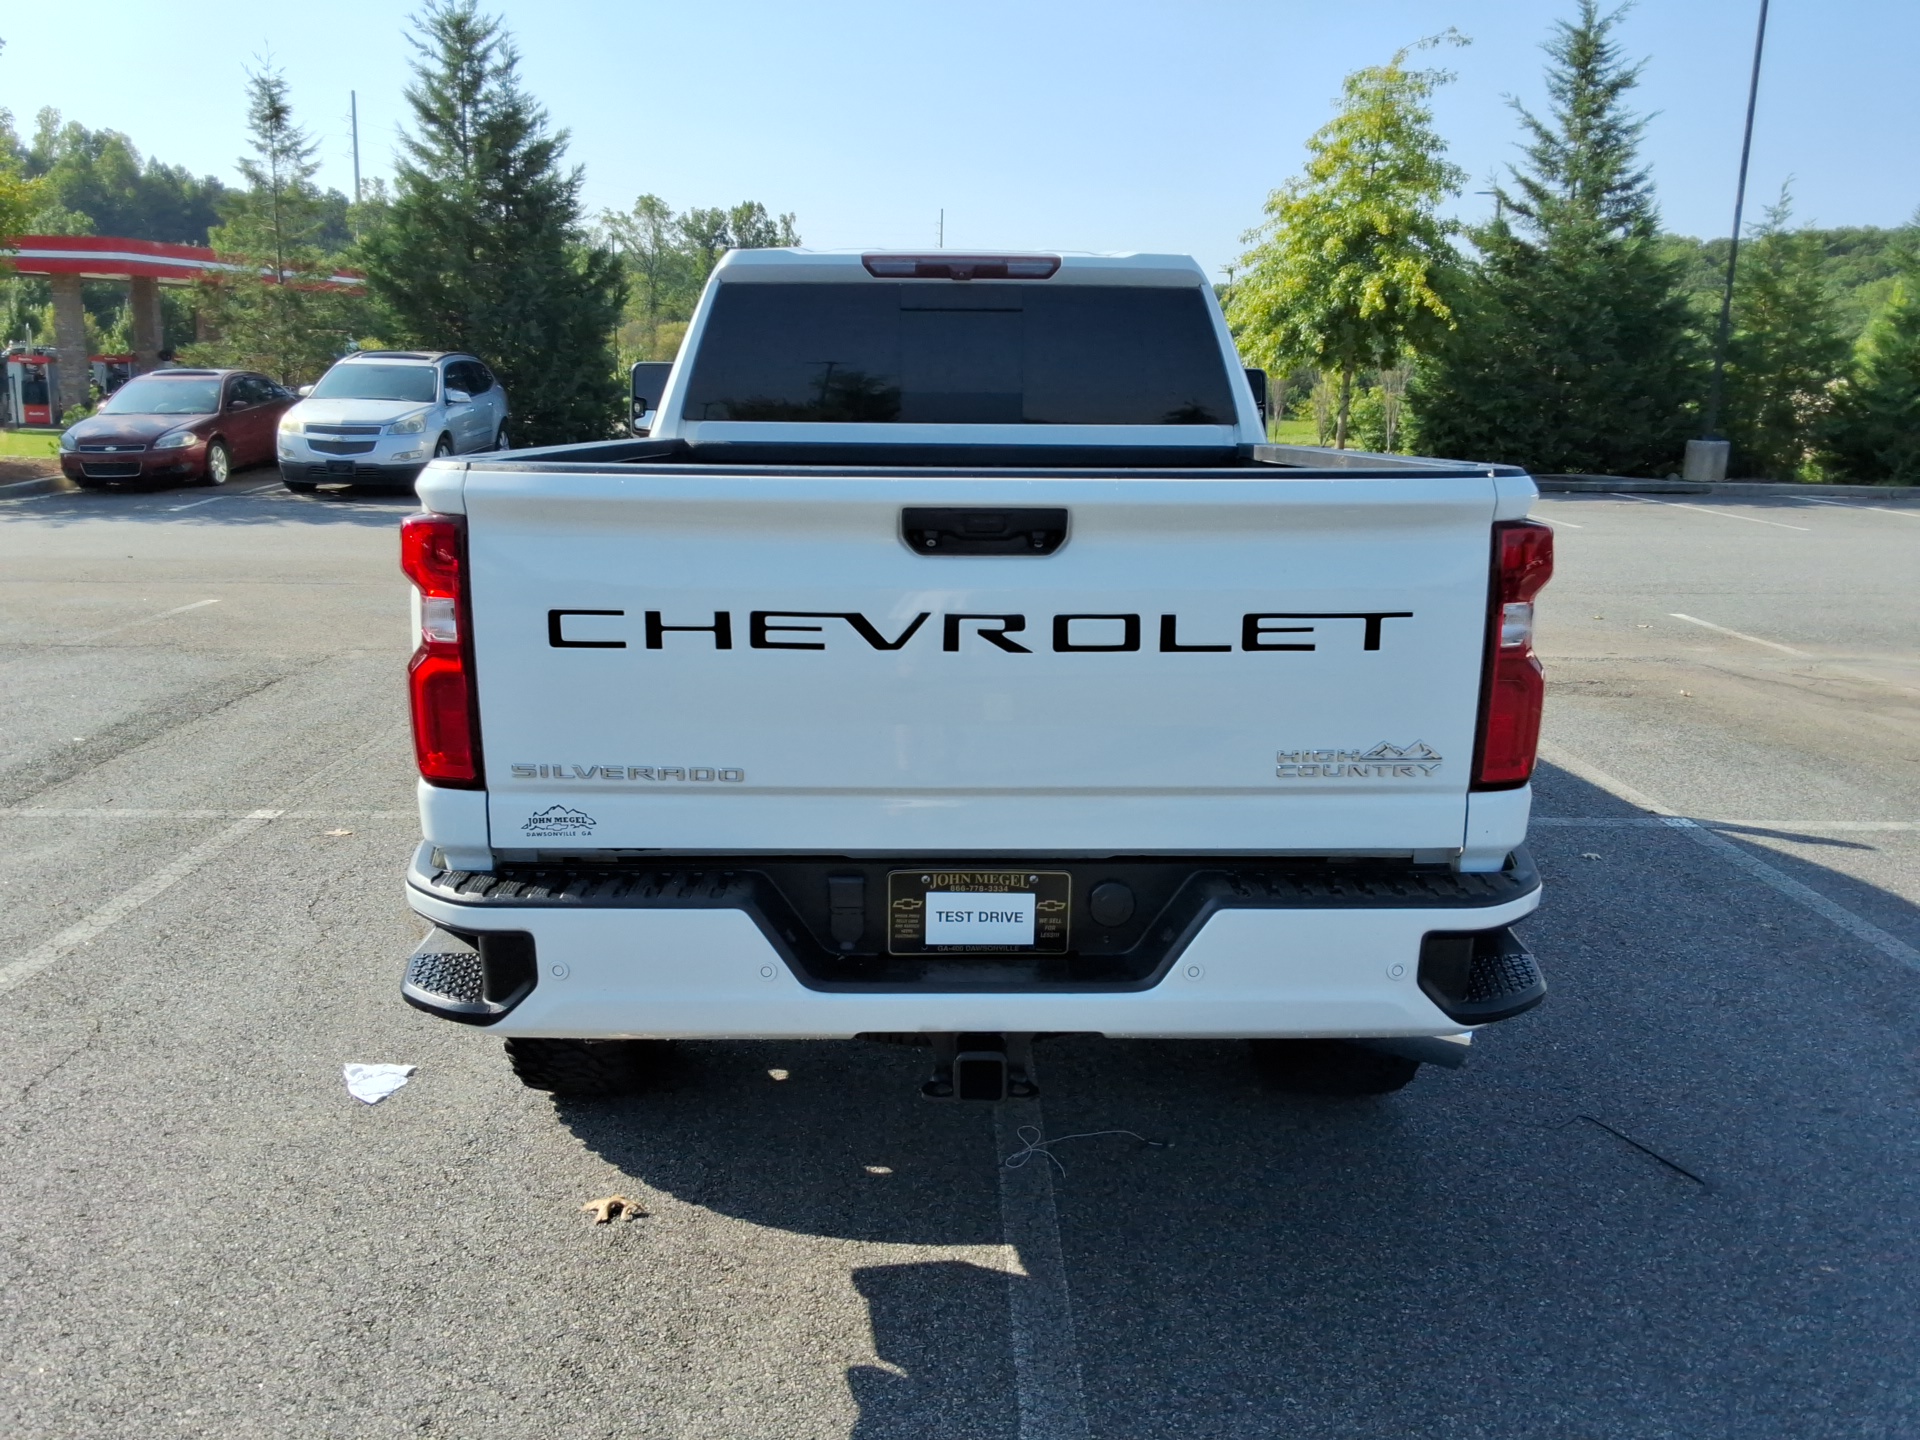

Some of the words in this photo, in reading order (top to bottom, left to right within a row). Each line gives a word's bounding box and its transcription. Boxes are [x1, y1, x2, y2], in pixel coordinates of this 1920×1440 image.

[547, 609, 1414, 653] CHEVROLET
[1276, 749, 1361, 763] HIGH
[511, 763, 745, 782] SILVERADO
[1276, 764, 1442, 778] COUNTRY
[528, 817, 552, 827] JOHN
[554, 816, 587, 824] MEGEL
[930, 874, 971, 889] JOHN
[975, 874, 1029, 888] MEGEL
[936, 911, 973, 923] TEST
[978, 911, 1024, 923] DRIVE
